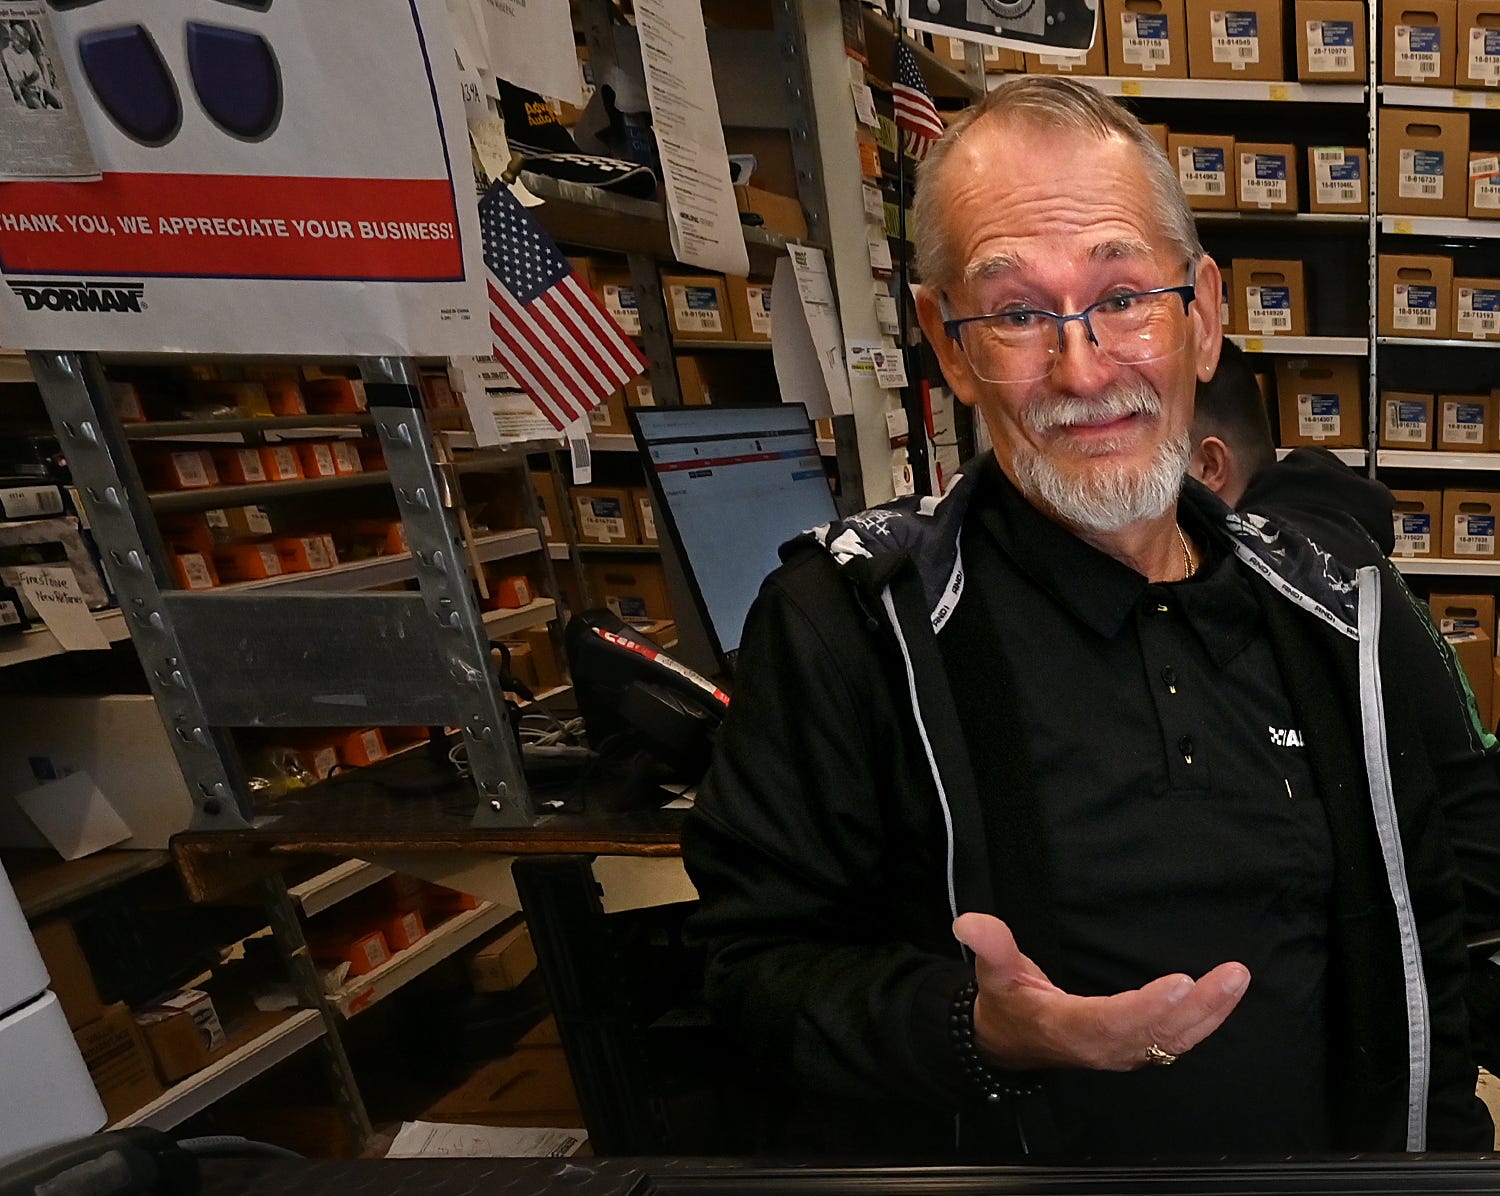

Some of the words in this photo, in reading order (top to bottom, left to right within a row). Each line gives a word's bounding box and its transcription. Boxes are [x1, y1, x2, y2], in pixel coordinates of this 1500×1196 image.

[0, 213, 63, 233] HANK
[65, 215, 116, 236] YOU,
[117, 216, 152, 235] WE
[159, 217, 290, 237] APPRECIATE
[291, 219, 355, 239] YOUR
[358, 221, 455, 240] BUSINESS!
[12, 286, 144, 313] DORMAN
